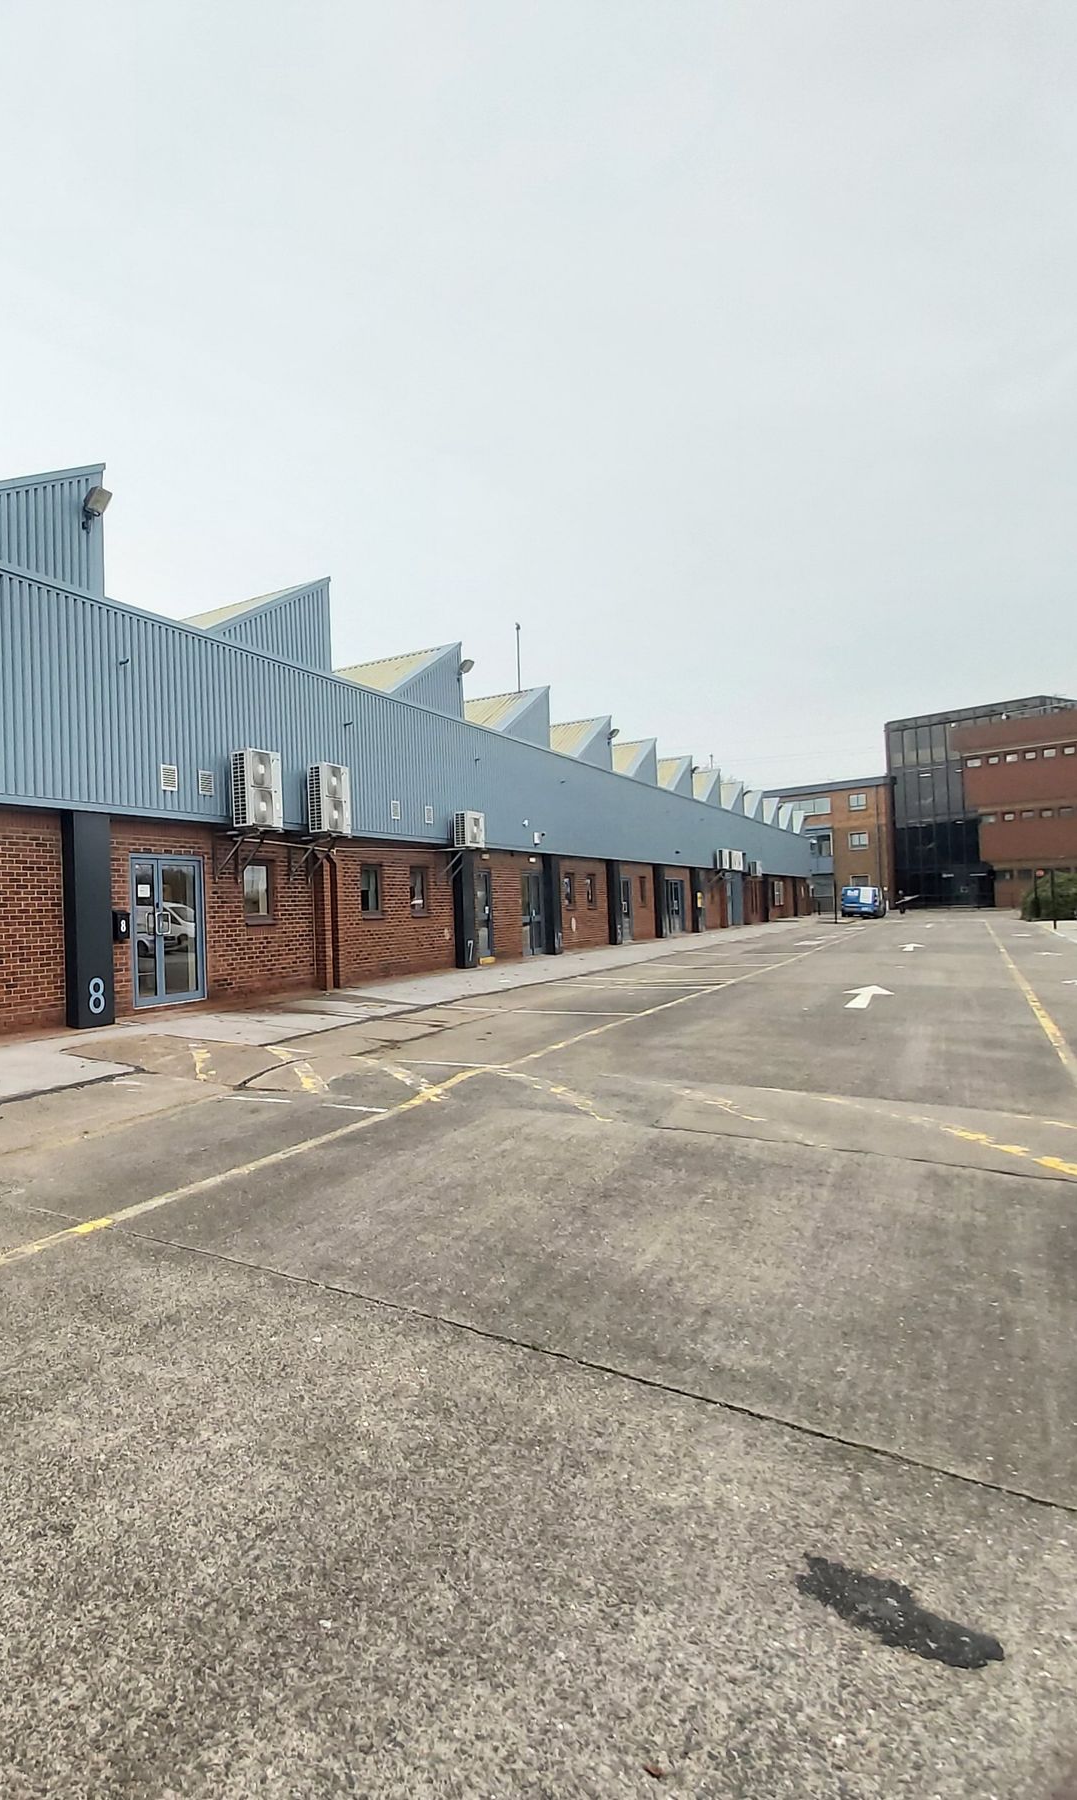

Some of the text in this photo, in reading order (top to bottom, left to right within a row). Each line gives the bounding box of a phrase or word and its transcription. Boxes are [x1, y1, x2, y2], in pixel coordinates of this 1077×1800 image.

[120, 919, 126, 932] 8
[467, 940, 473, 961] 7
[88, 977, 105, 1014] 8
